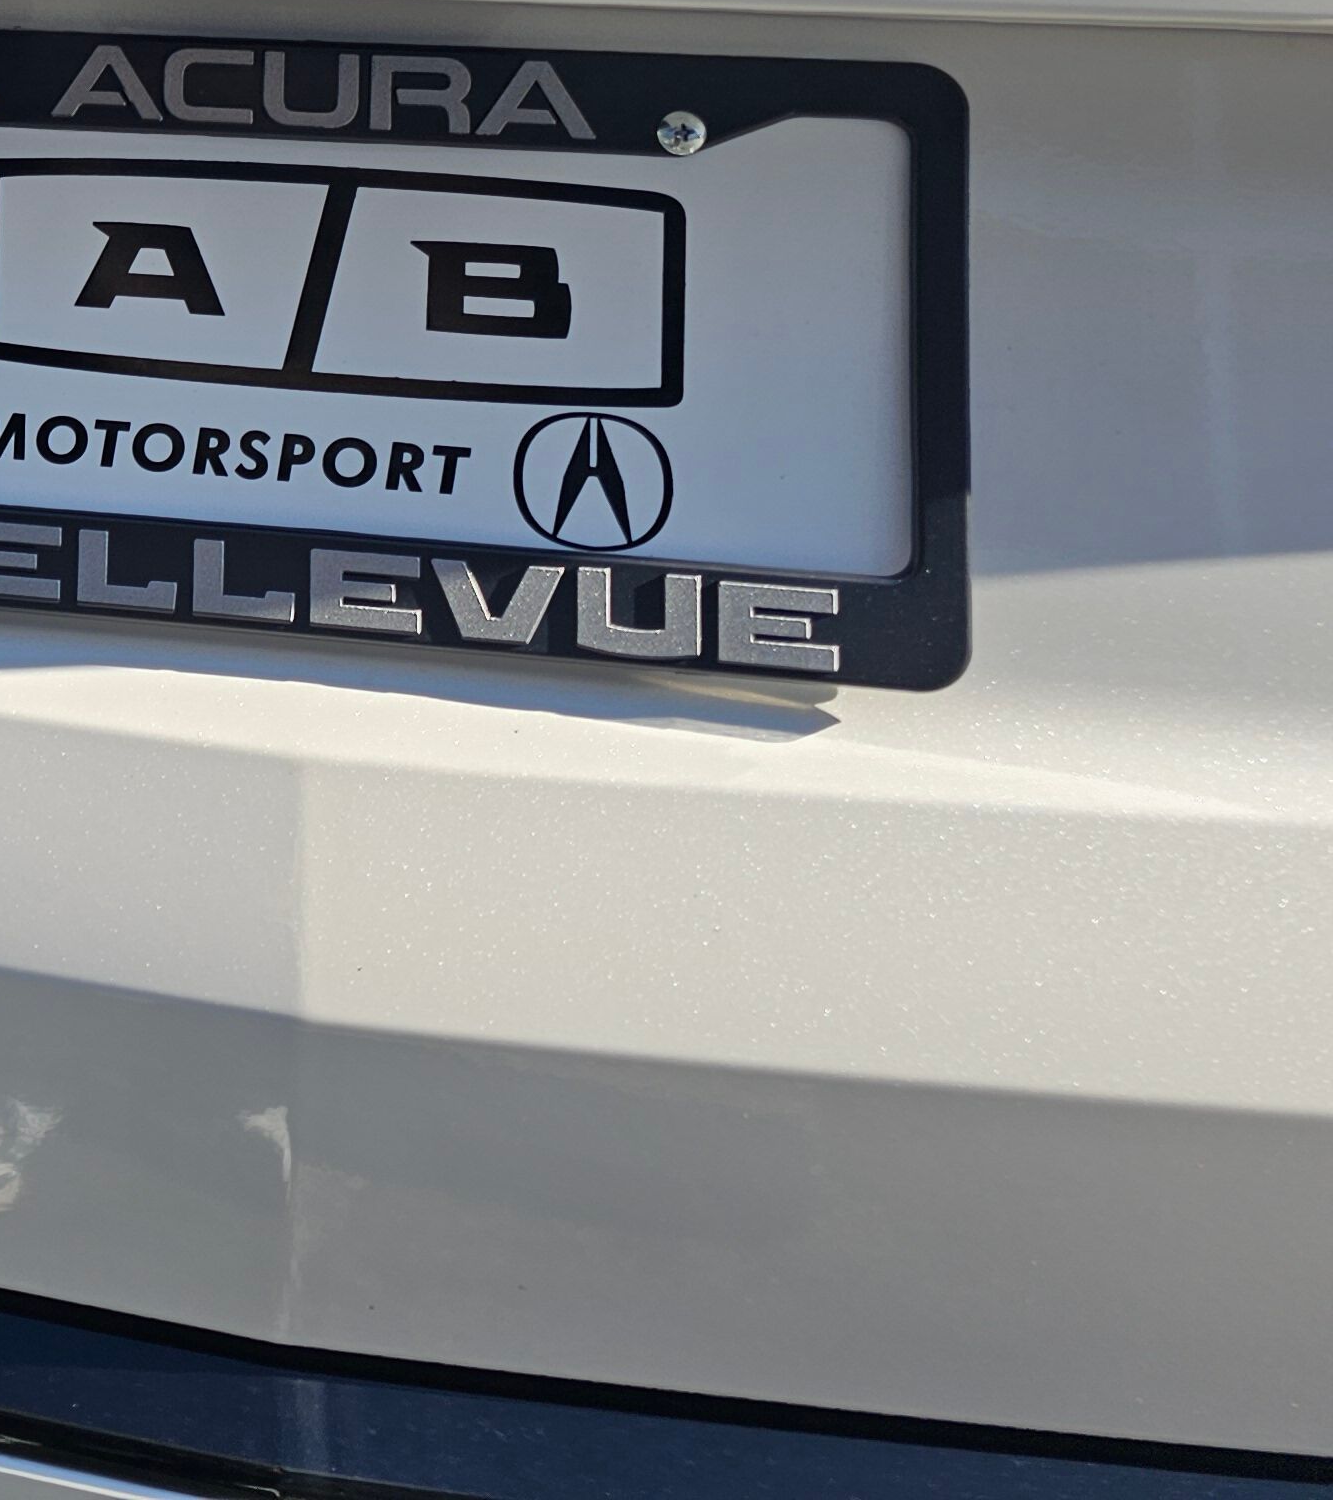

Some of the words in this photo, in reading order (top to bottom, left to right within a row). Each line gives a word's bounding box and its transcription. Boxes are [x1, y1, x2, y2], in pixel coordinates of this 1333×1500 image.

[51, 44, 597, 140] ACURA
[75, 222, 226, 317] A
[411, 241, 572, 340] B
